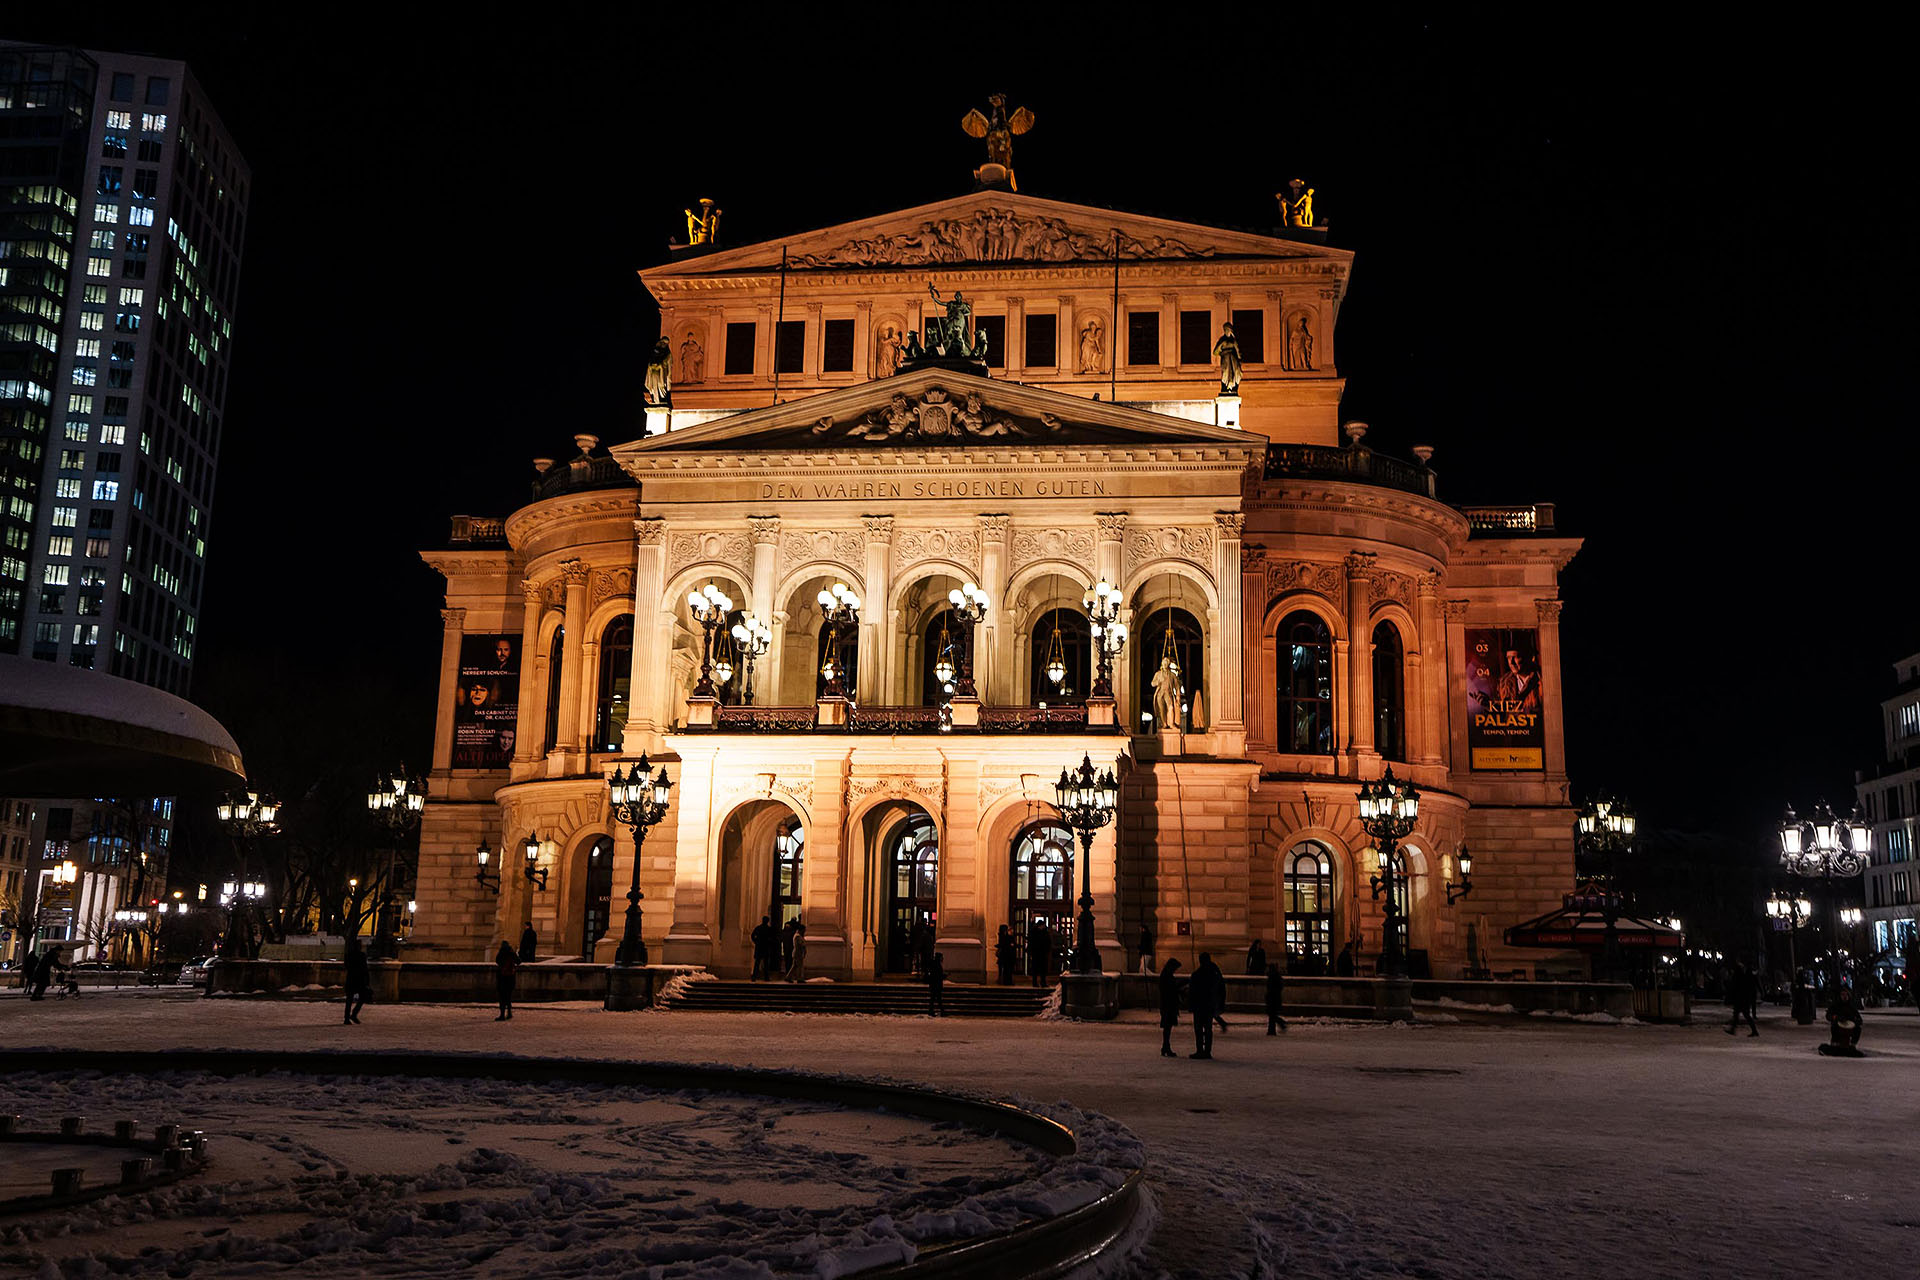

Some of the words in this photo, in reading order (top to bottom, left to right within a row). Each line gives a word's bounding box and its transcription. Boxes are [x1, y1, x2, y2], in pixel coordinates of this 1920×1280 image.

[762, 484, 803, 498] DEM
[814, 482, 902, 498] WAHREN
[913, 481, 1025, 496] SCHOENEN
[1036, 480, 1113, 495] GUTEN.
[1489, 700, 1524, 713] KIEZ
[1475, 714, 1537, 727] PALAST
